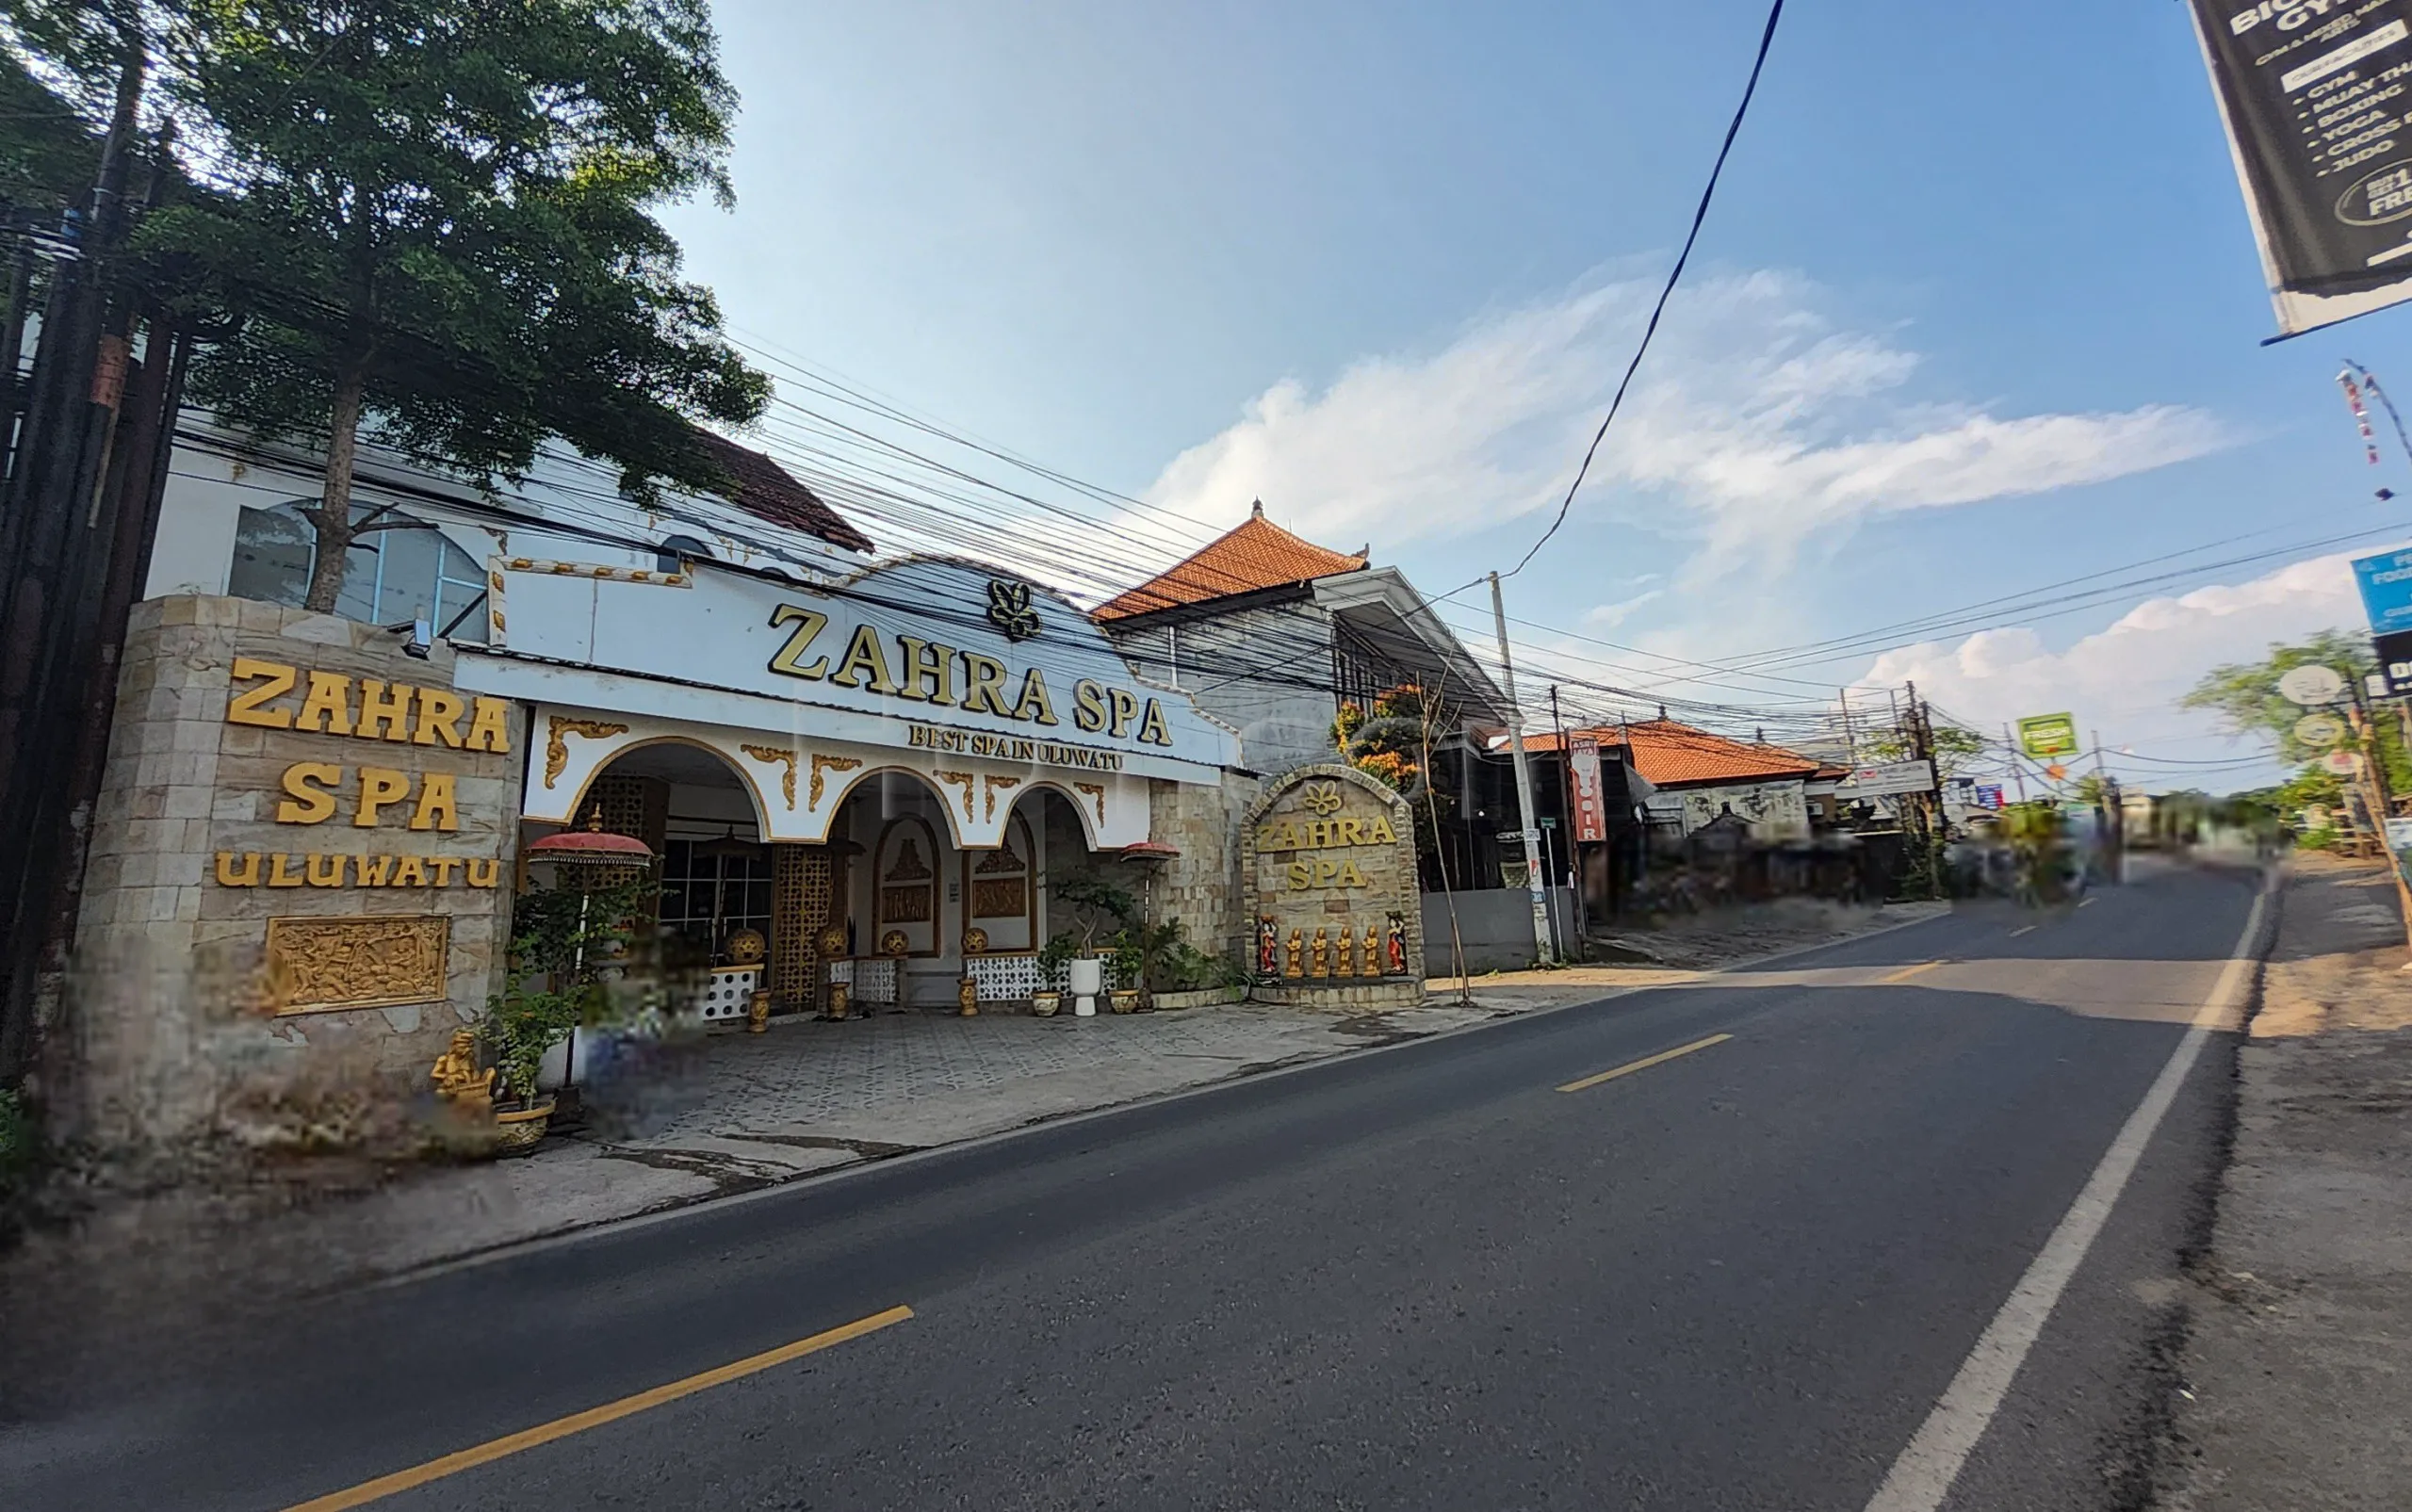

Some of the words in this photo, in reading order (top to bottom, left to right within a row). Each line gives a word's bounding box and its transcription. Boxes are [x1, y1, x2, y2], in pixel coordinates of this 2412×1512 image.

[2276, 0, 2348, 31] GY
[2313, 78, 2376, 112] MUAY
[2318, 84, 2404, 128] BOXING
[2321, 109, 2387, 141] YOGA
[2327, 118, 2402, 155] CROSS
[2331, 138, 2396, 171] JUDO
[767, 602, 1060, 726] ZAHRA
[1071, 678, 1173, 748] SPA
[227, 658, 511, 754] ZAHRA
[908, 724, 970, 754] BEST
[970, 734, 1010, 759] SPA
[1011, 739, 1035, 761] IN
[1036, 741, 1125, 772] ULUWATU
[277, 761, 460, 832] SPA
[1254, 814, 1397, 853] ZAHRA
[214, 851, 500, 889] ULUWATU
[1287, 859, 1367, 891] SPA
